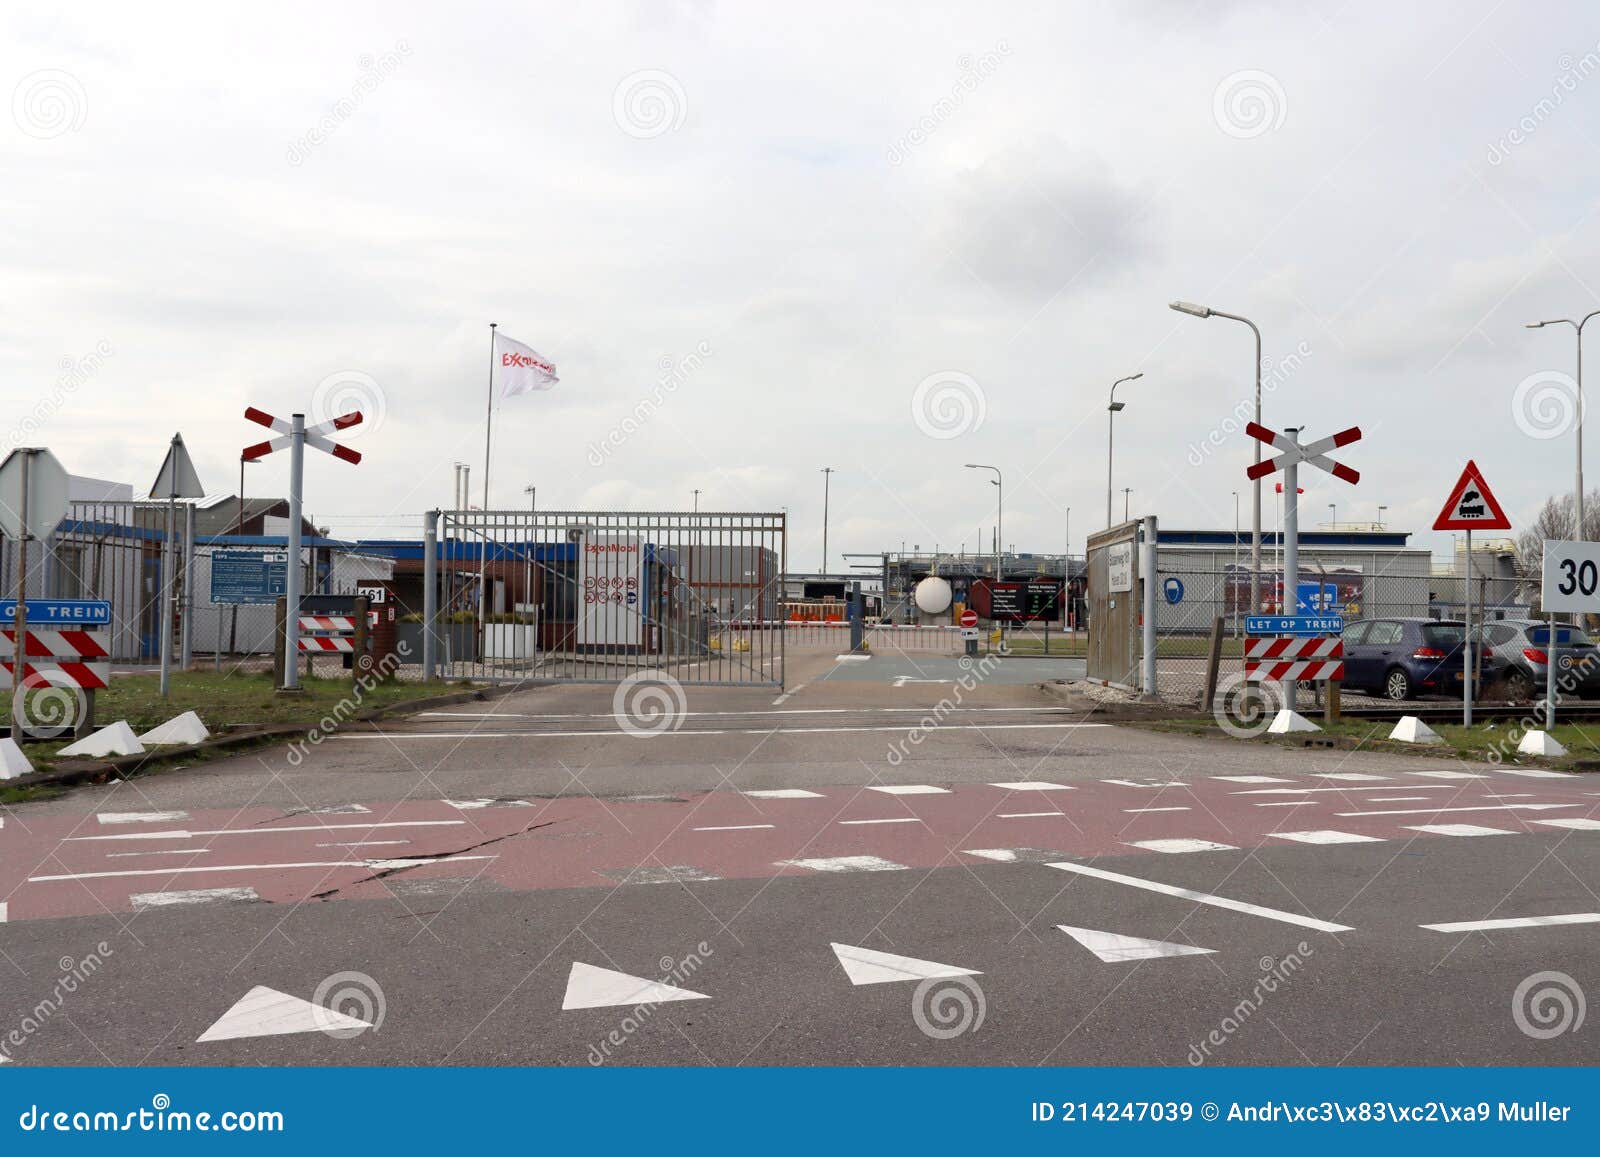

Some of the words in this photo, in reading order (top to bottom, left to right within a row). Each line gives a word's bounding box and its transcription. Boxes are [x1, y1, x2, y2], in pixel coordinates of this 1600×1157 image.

[1558, 558, 1598, 596] 30
[47, 606, 105, 618] TREIN
[1249, 620, 1271, 629] LET
[1280, 620, 1296, 629] OP
[1305, 620, 1340, 629] TREIN
